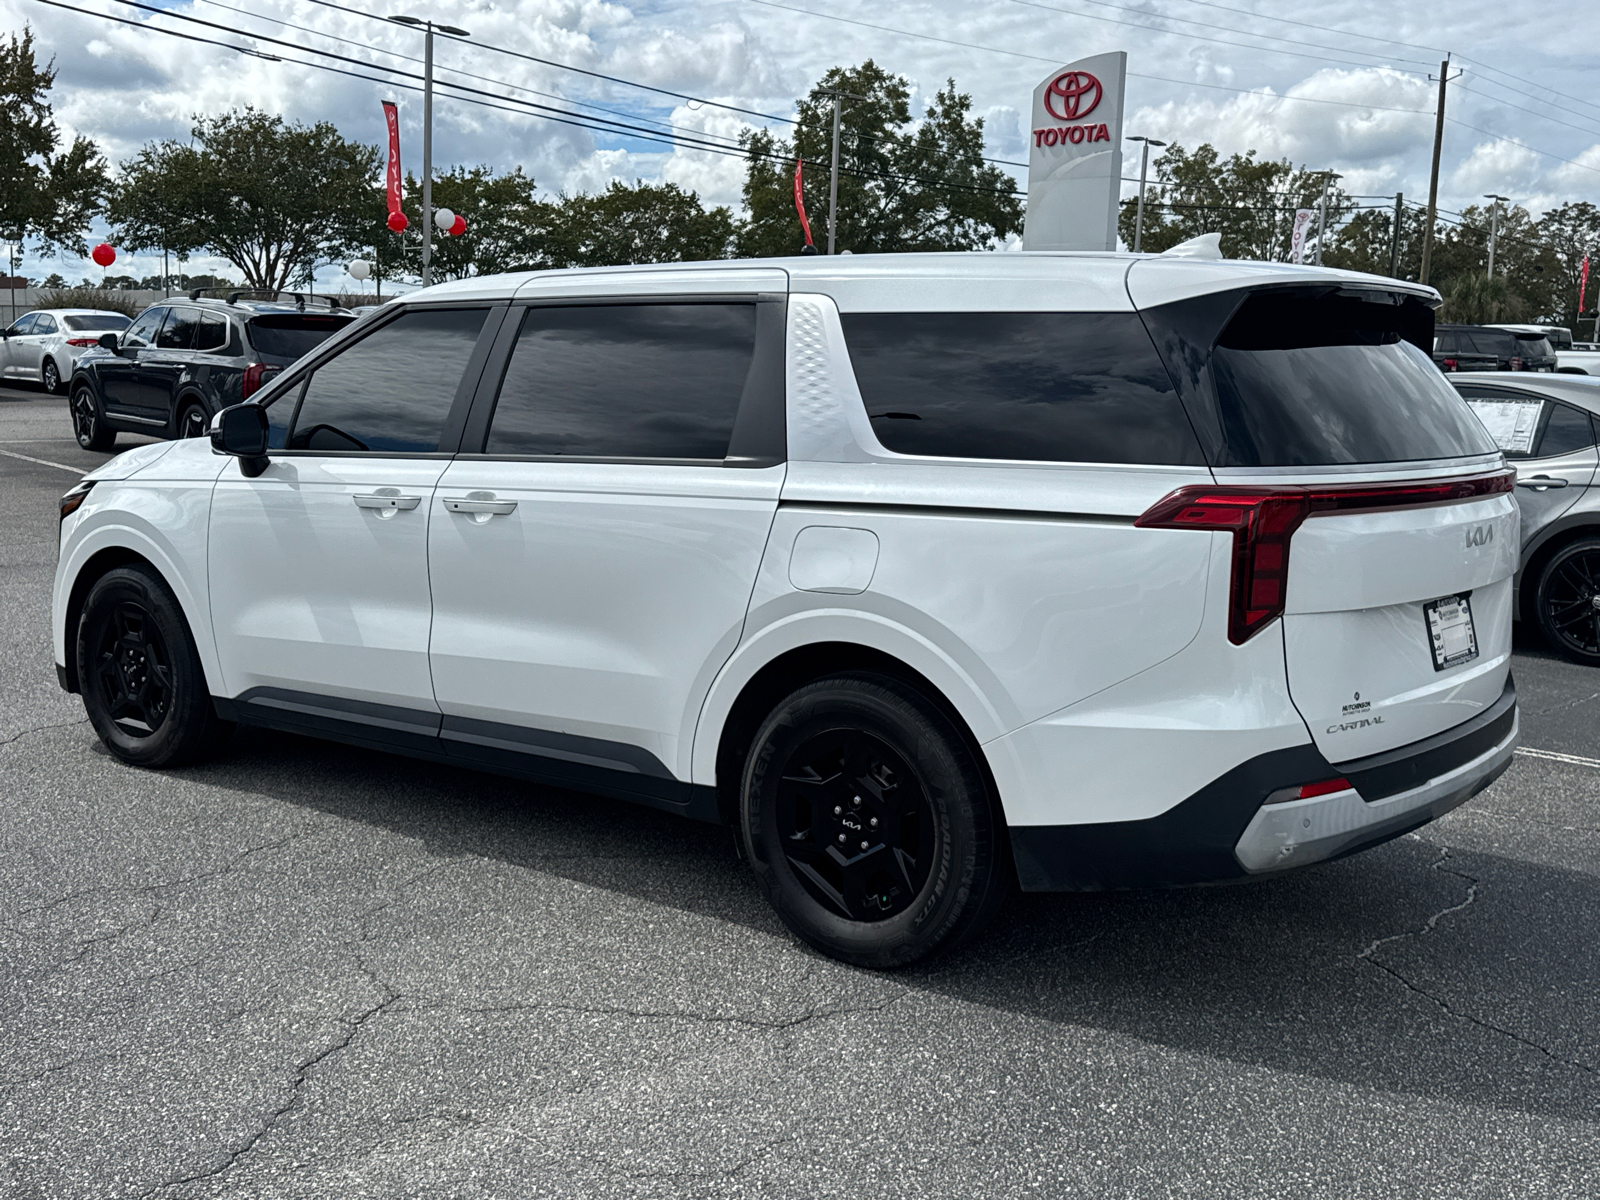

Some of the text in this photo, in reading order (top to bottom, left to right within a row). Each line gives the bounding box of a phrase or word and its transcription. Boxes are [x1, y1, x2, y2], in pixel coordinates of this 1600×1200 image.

[1033, 123, 1110, 148] TOYOTA
[1465, 523, 1493, 548] KIA
[749, 741, 776, 835] NEXEN
[842, 819, 861, 831] KIA
[936, 797, 952, 898] ROADIAN
